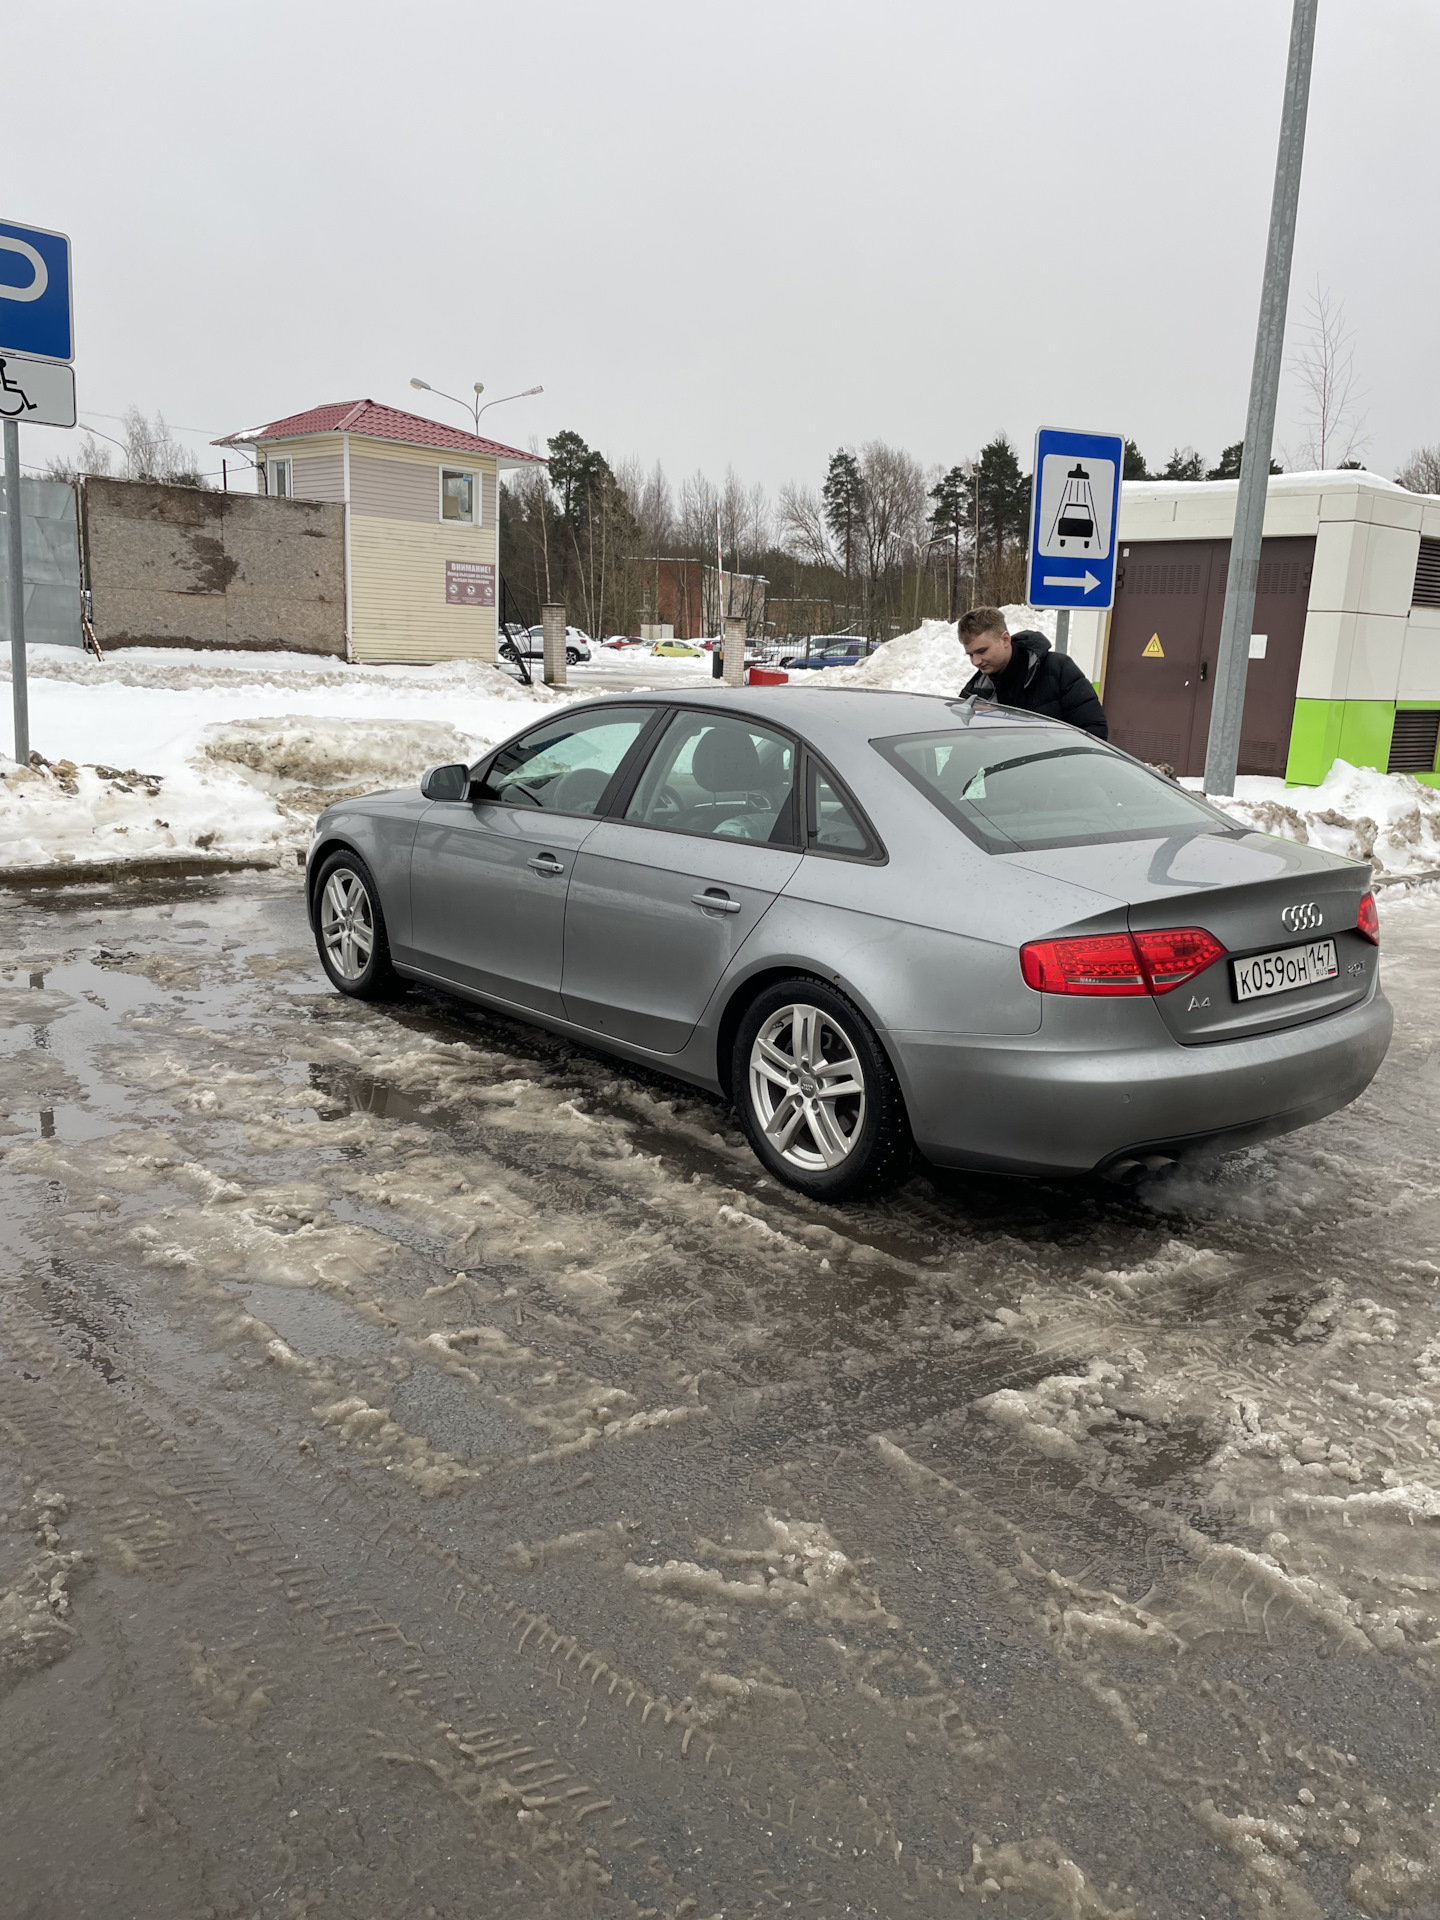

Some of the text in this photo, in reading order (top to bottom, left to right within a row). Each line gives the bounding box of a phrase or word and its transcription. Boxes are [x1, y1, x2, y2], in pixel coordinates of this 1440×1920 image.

[452, 563, 491, 573] ВНИМАНИЕ!
[1309, 943, 1331, 968] 147
[1316, 969, 1328, 977] RUS
[1188, 995, 1211, 1011] A4
